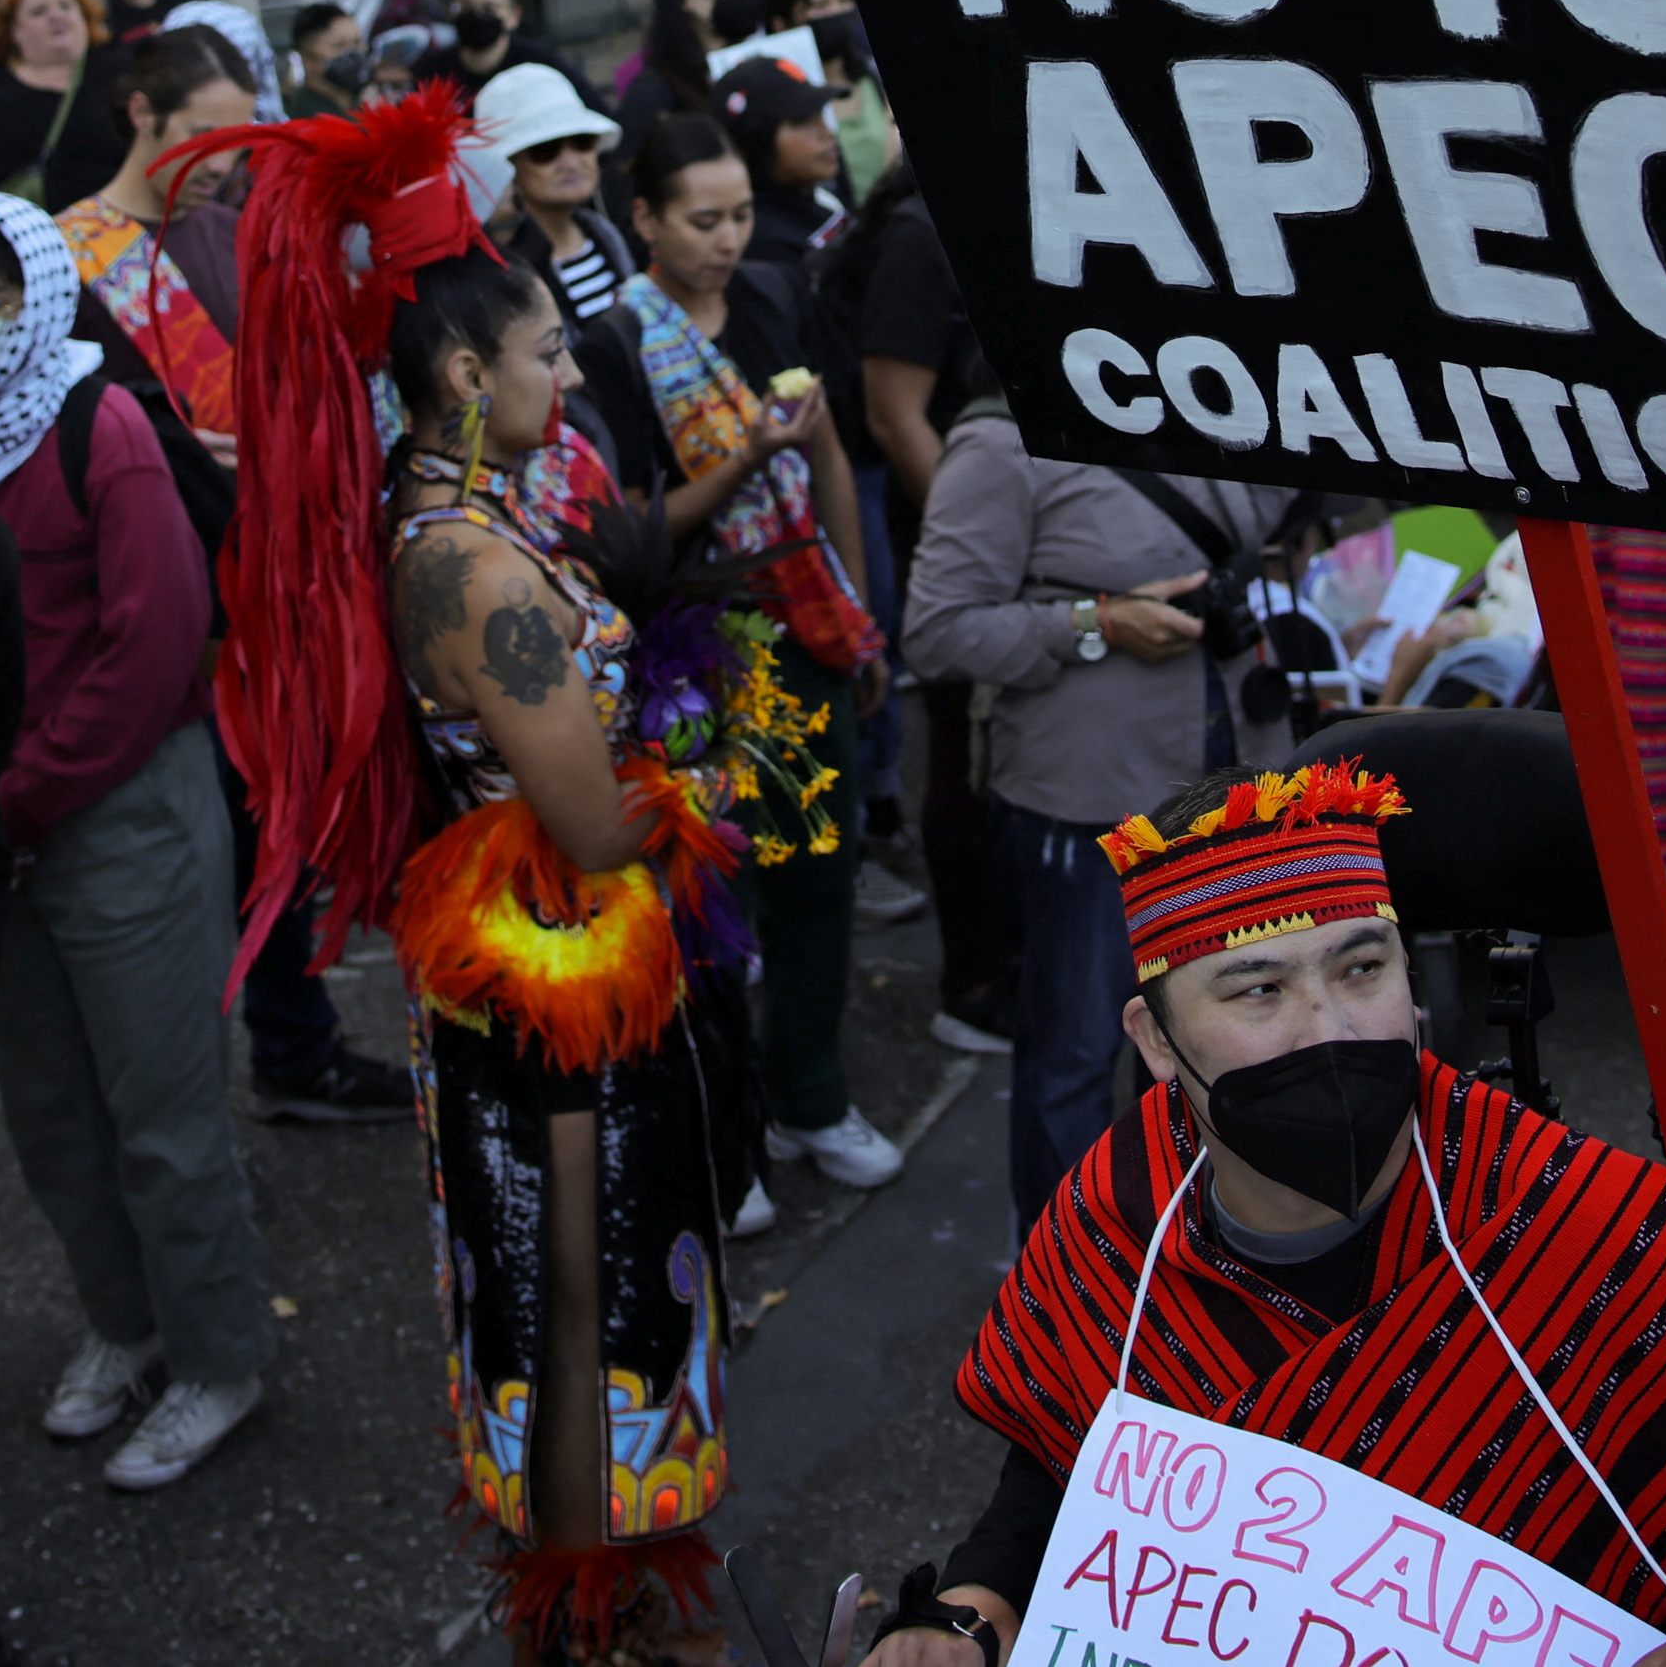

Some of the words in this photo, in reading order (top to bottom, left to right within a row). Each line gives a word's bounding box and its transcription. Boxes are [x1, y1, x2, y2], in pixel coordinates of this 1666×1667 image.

[1093, 1419, 1229, 1534] NO
[1231, 1465, 1329, 1576] 2
[1064, 1529, 1258, 1661] APEC
